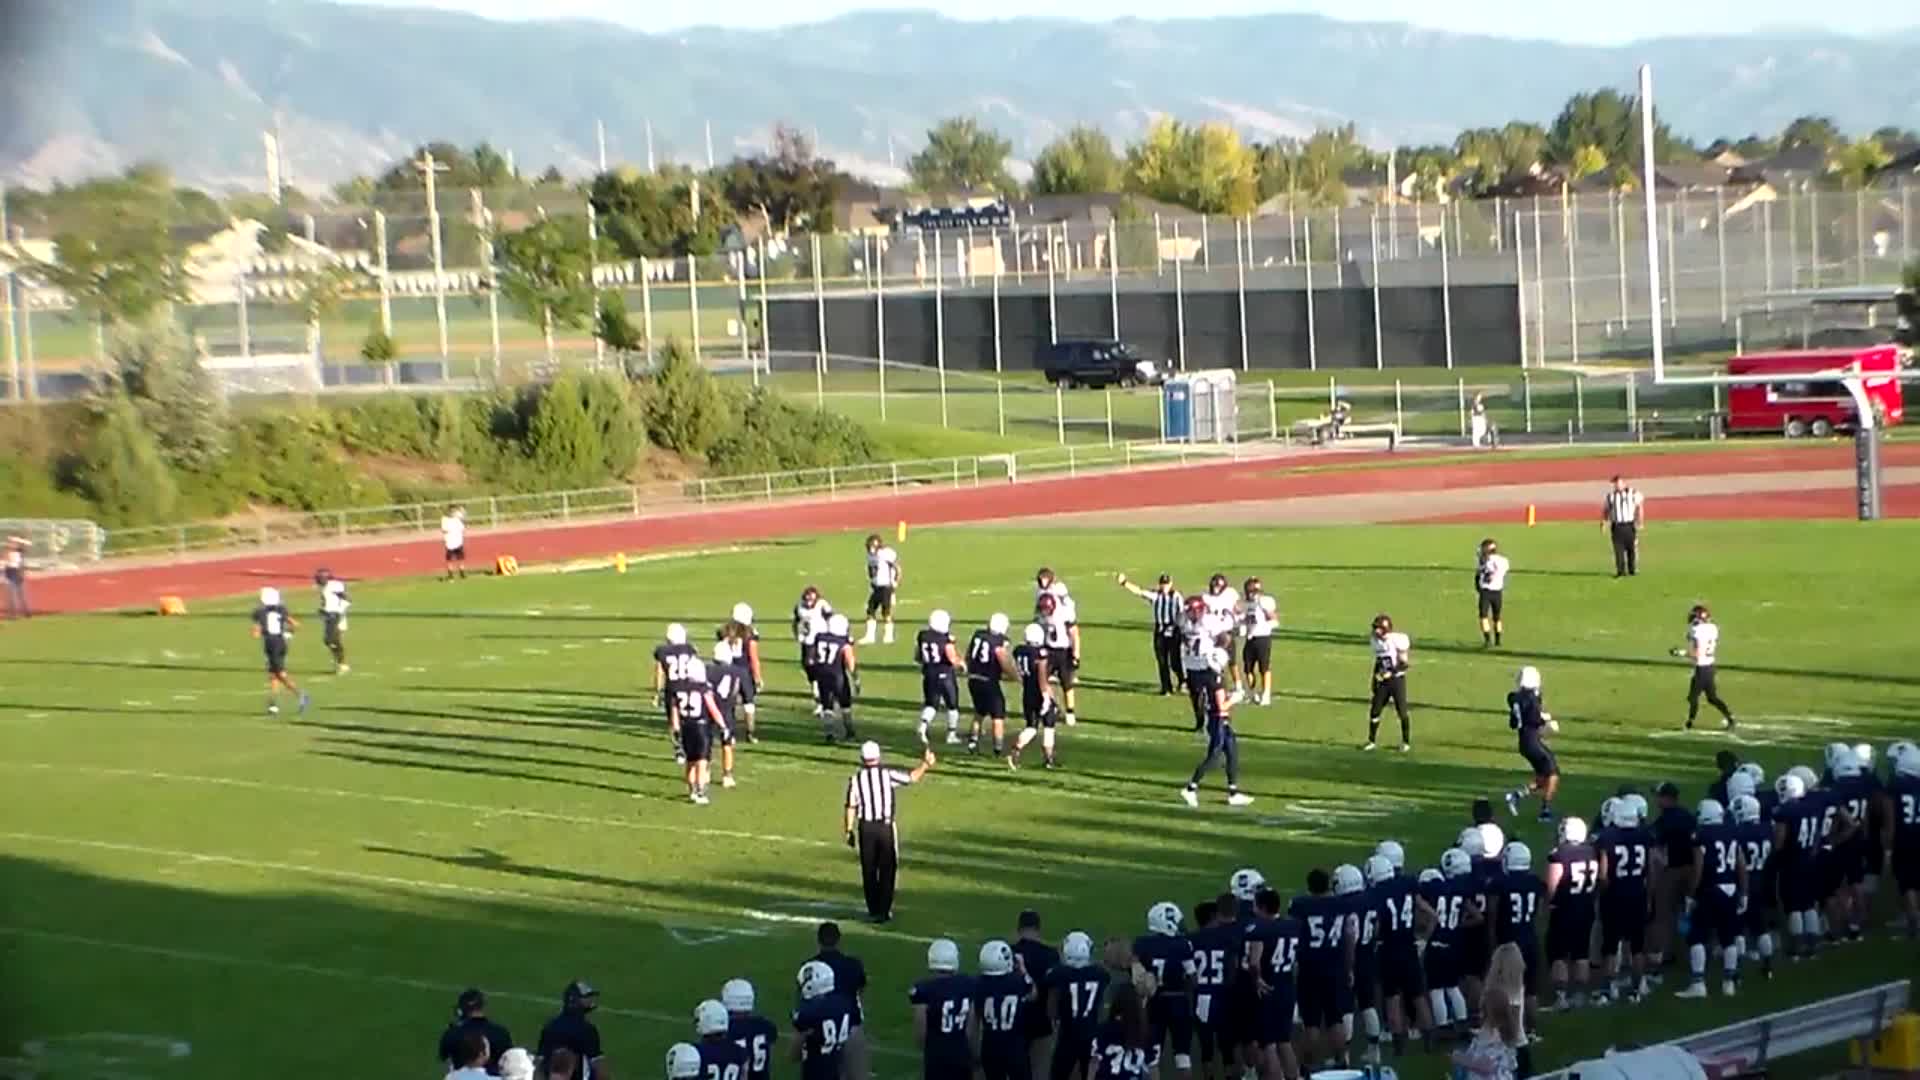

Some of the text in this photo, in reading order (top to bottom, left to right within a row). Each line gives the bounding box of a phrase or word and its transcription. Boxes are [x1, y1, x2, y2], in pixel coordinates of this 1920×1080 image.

[1615, 845, 1646, 877] 23
[1715, 840, 1738, 873] 34
[1385, 894, 1413, 931] 14
[1509, 891, 1537, 923] 31
[1307, 913, 1346, 949] 54
[1194, 949, 1225, 985] 25
[1270, 937, 1299, 973] 45
[941, 997, 970, 1033] 64
[983, 994, 1019, 1031] 40
[1069, 980, 1099, 1018] 17
